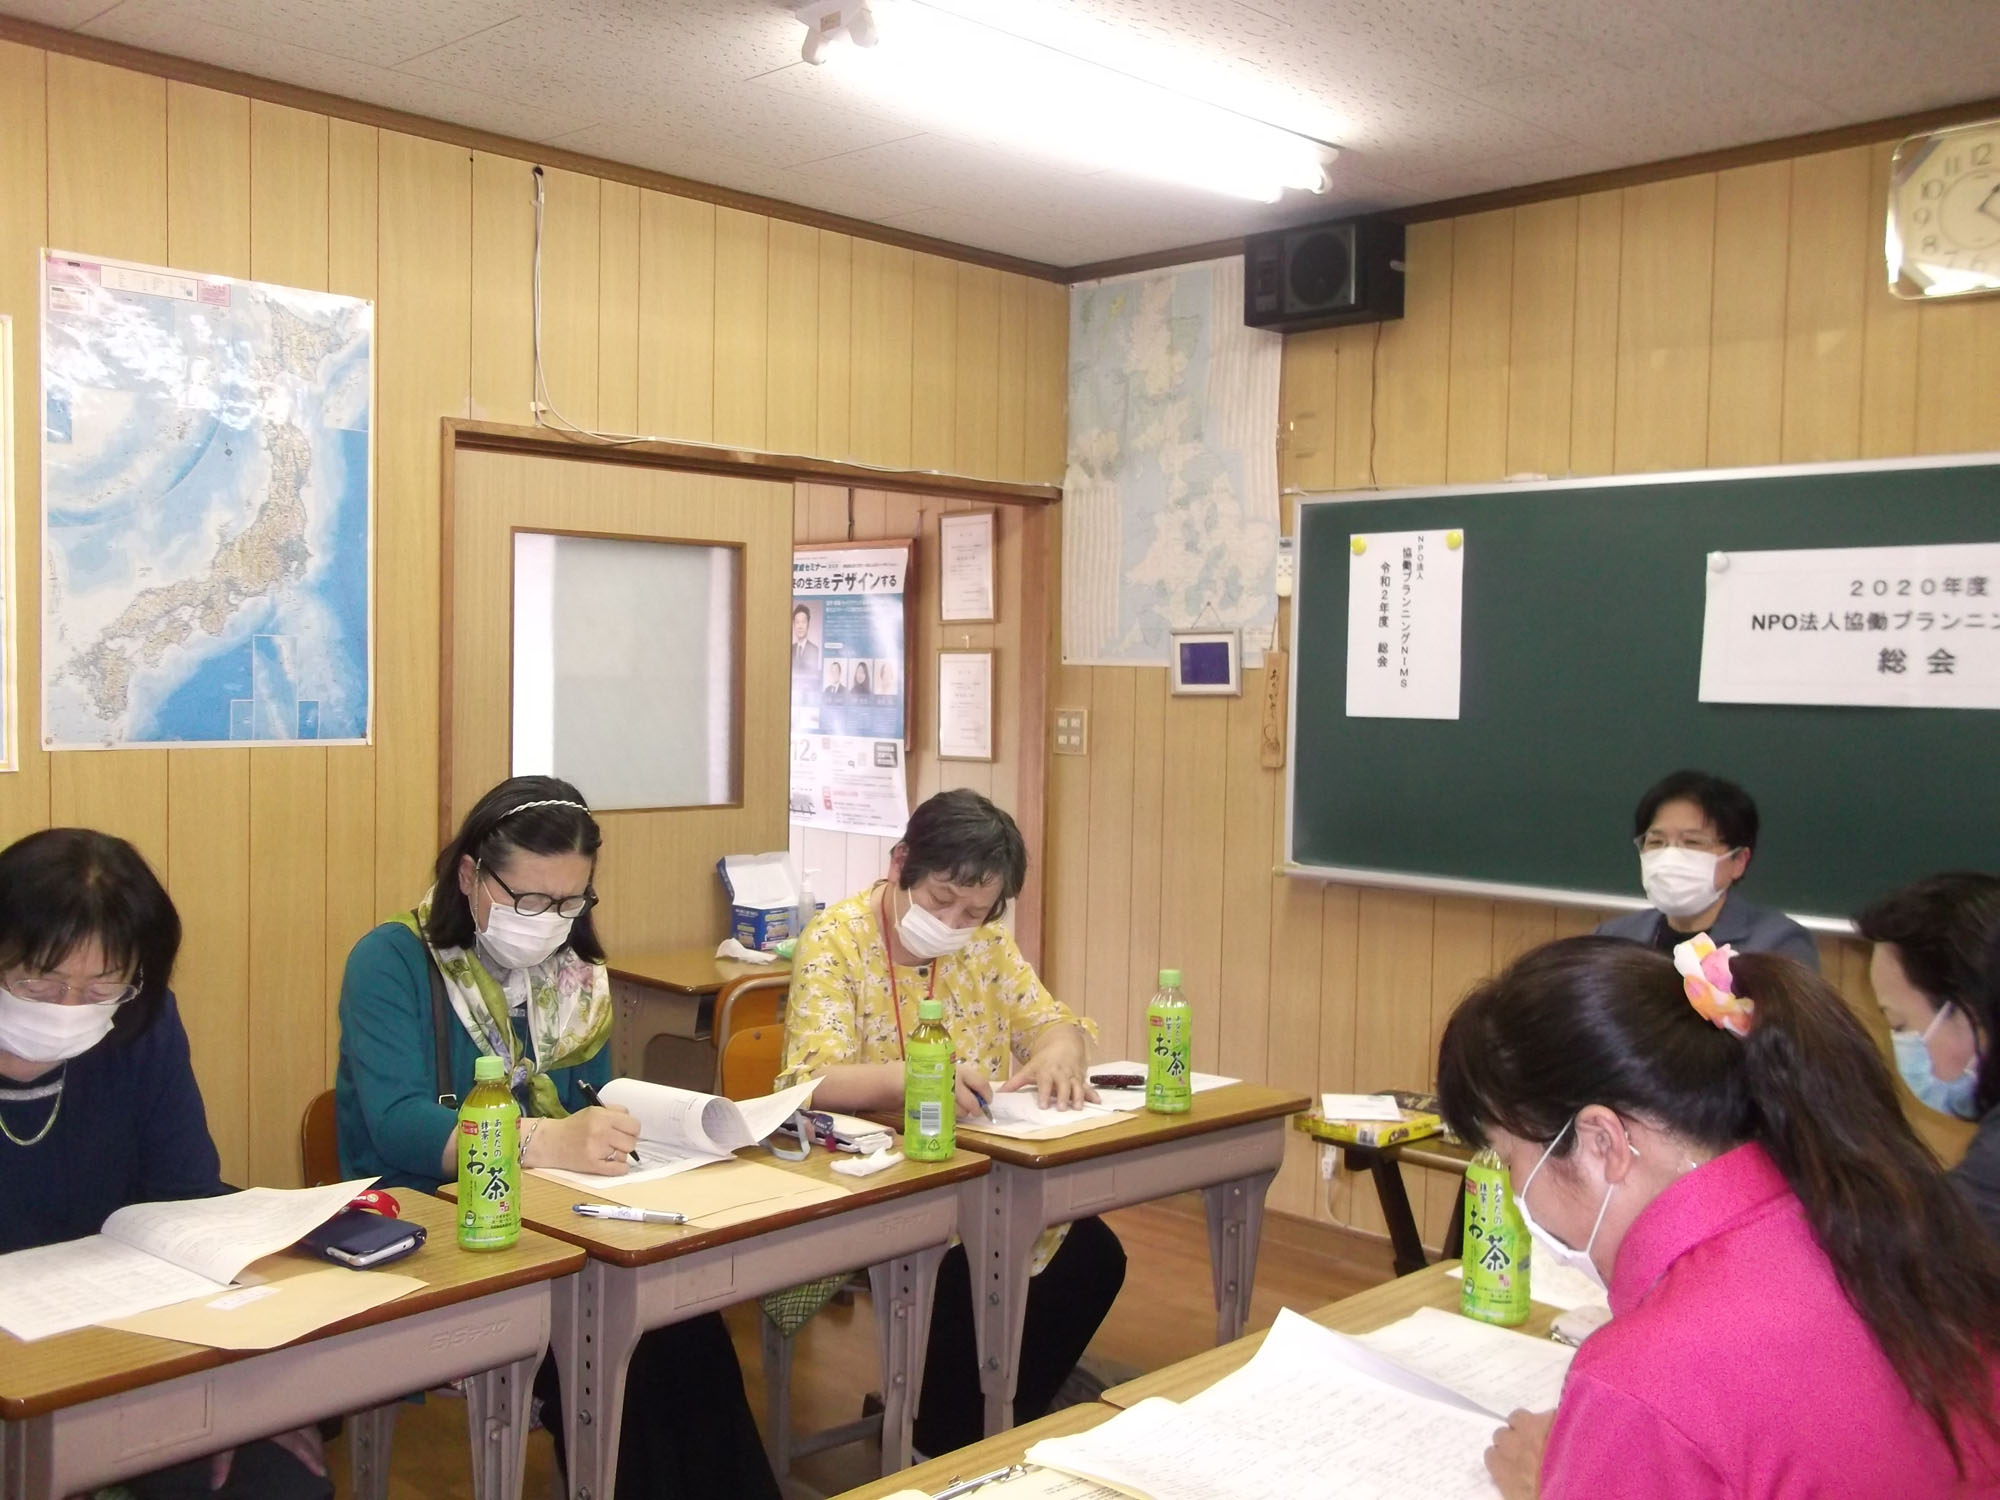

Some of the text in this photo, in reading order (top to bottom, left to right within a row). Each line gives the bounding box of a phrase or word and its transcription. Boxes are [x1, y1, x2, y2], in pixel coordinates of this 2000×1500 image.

[1970, 142, 1992, 166] 12
[1945, 156, 1960, 177] 11
[1920, 179, 1944, 201] 10
[1913, 207, 1931, 229] 9
[1922, 235, 1937, 256] 8
[1377, 562, 1391, 667] 令和2年度 総会
[466, 1143, 510, 1200] お茶
[1468, 1203, 1511, 1272] お茶
